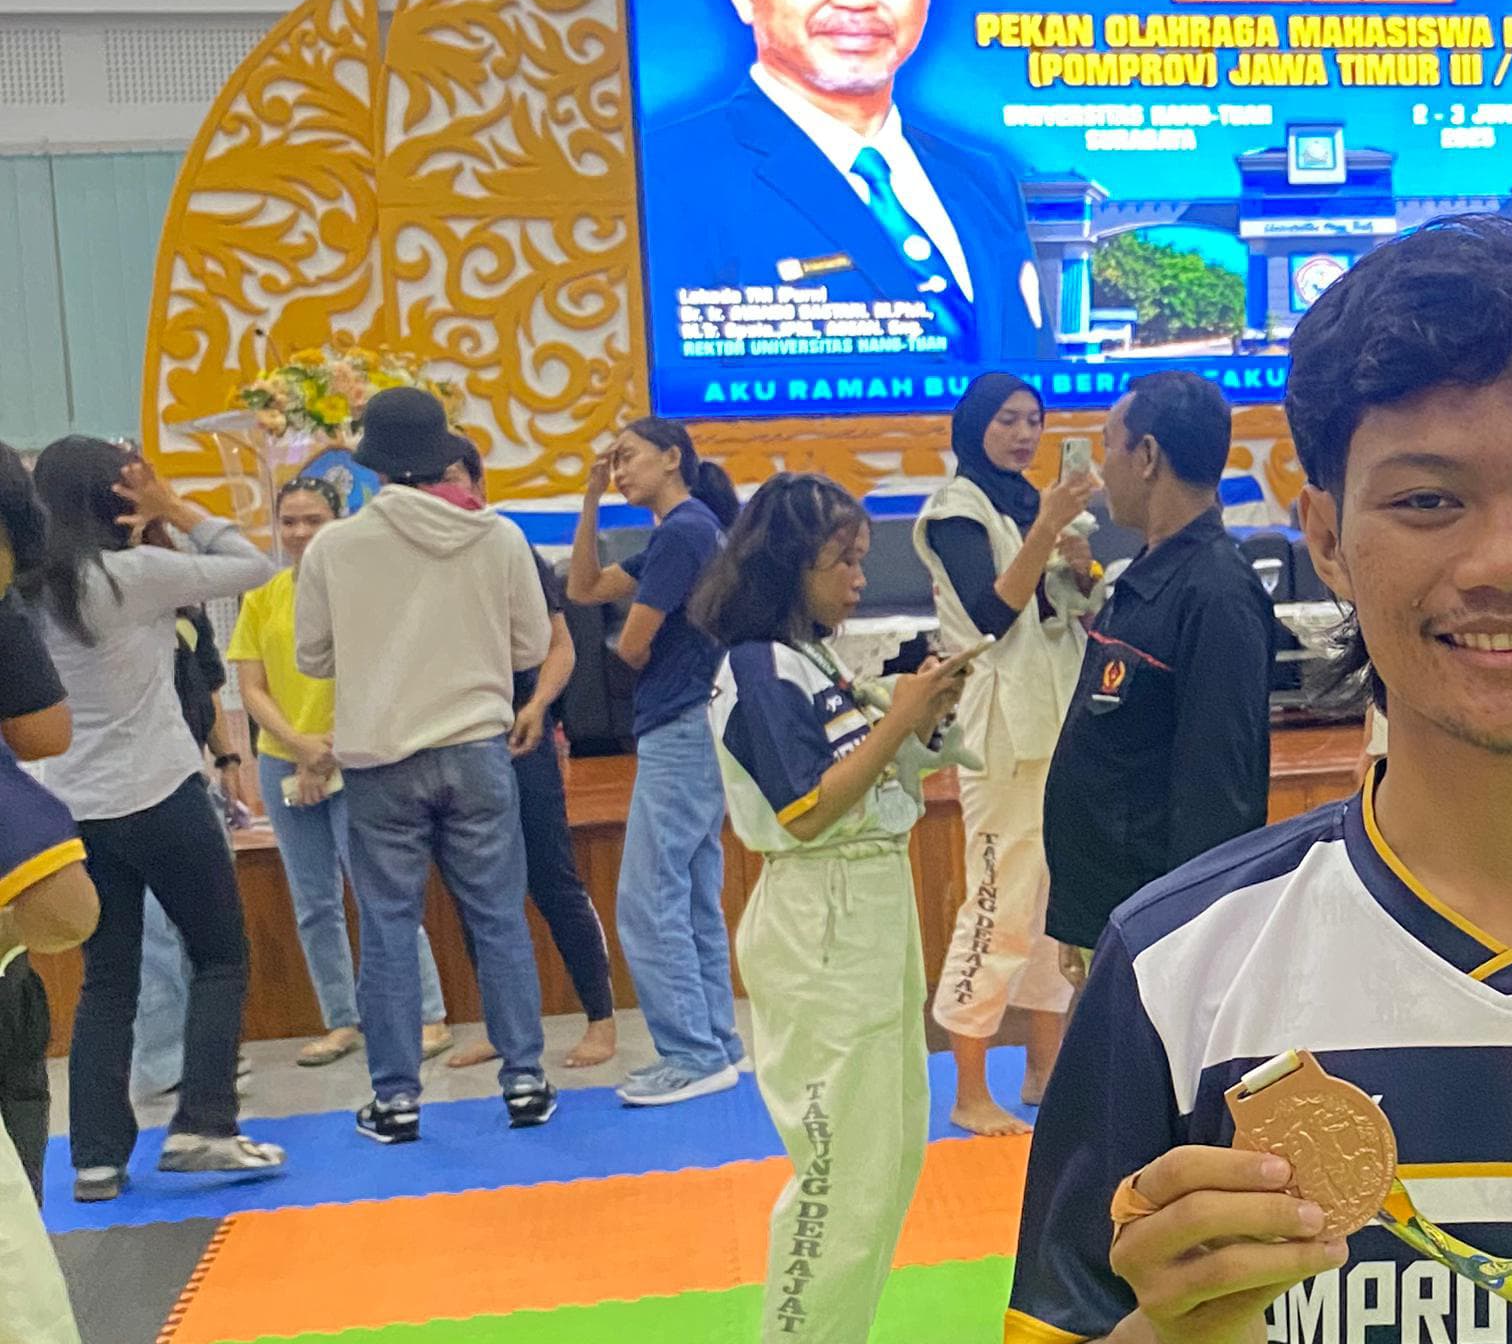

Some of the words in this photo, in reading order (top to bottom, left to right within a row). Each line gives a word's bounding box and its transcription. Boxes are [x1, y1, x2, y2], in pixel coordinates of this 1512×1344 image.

[975, 13, 1094, 48] PEKAN
[1105, 14, 1280, 48] OLAHRAGA
[1287, 15, 1495, 48] MAHASISWA
[1028, 52, 1218, 87] (POMPROV)
[1228, 52, 1329, 86] JAWA
[1335, 52, 1441, 87] TIMUR
[1449, 52, 1483, 86] III
[749, 337, 853, 356] UNIVERSITAS
[704, 380, 777, 403] AKU
[788, 377, 914, 401] RAMAH
[954, 912, 995, 1005] DERAJAT
[801, 1081, 833, 1197] TARUNG
[777, 1200, 830, 1334] DERAJAT
